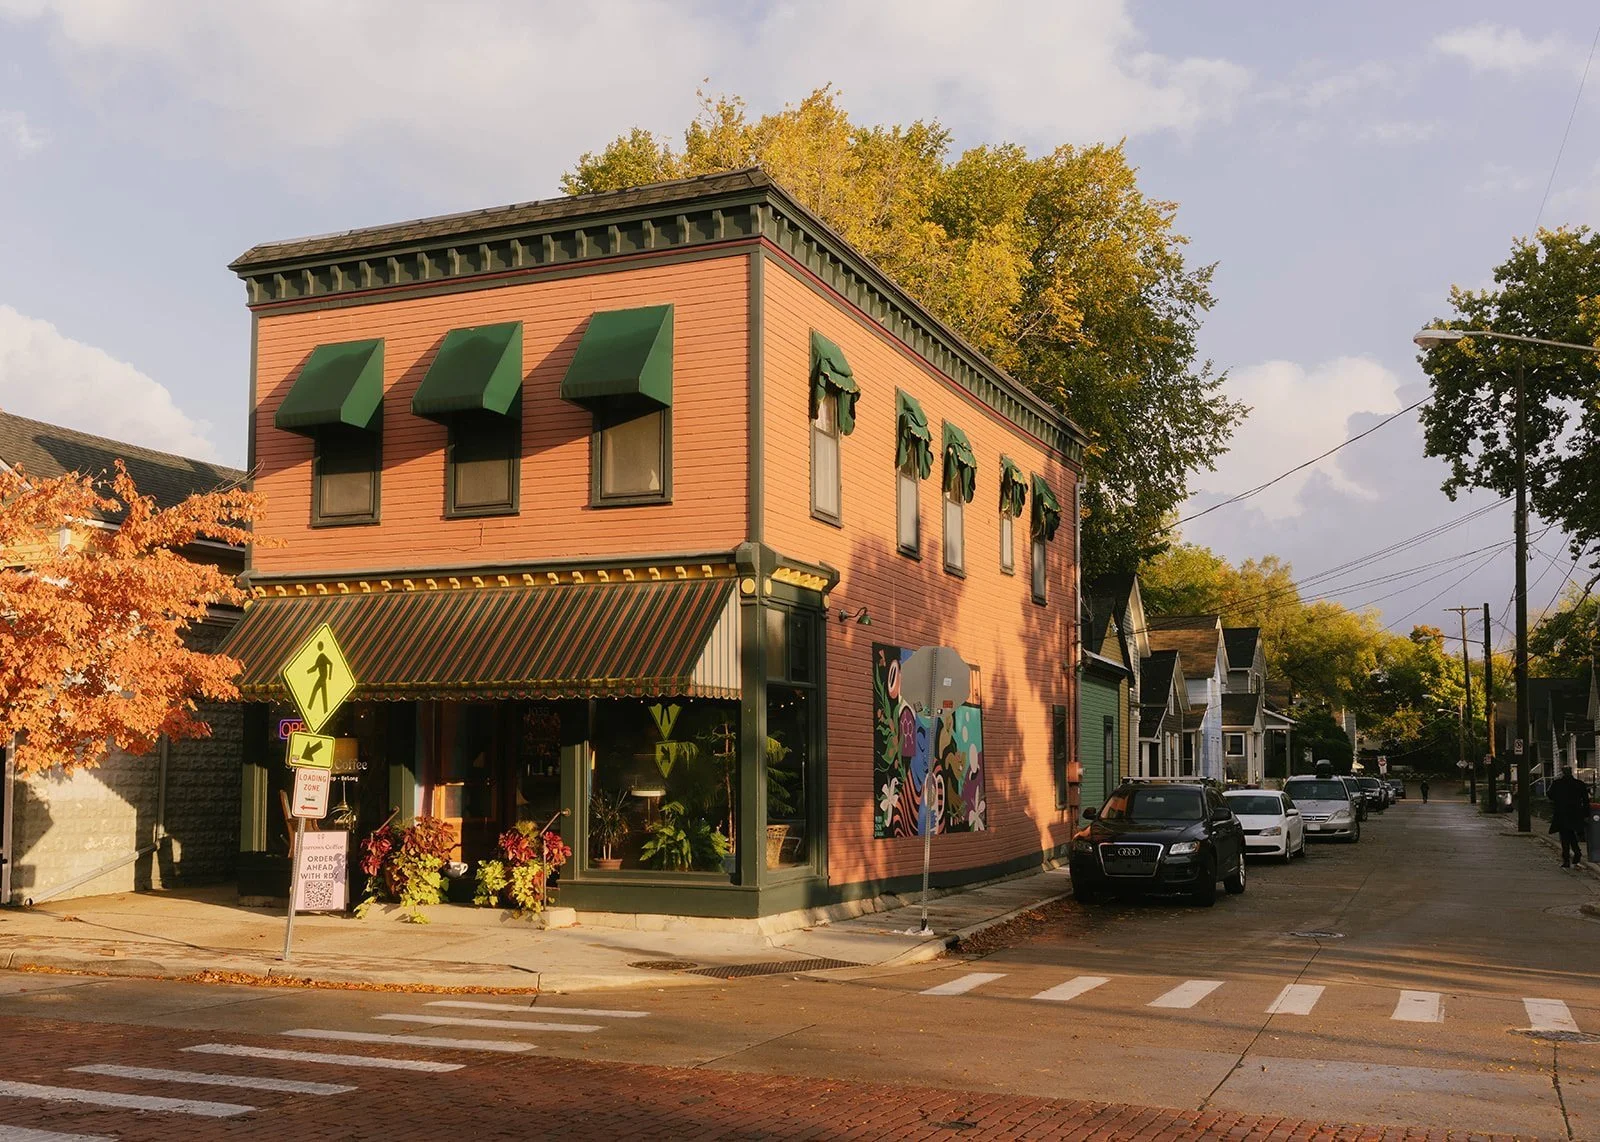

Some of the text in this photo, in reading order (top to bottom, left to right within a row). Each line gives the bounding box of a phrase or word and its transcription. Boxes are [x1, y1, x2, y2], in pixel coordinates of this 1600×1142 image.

[281, 722, 308, 737] OPE
[334, 758, 368, 770] Coffee
[299, 774, 327, 783] LOADING
[303, 784, 320, 792] ZONE
